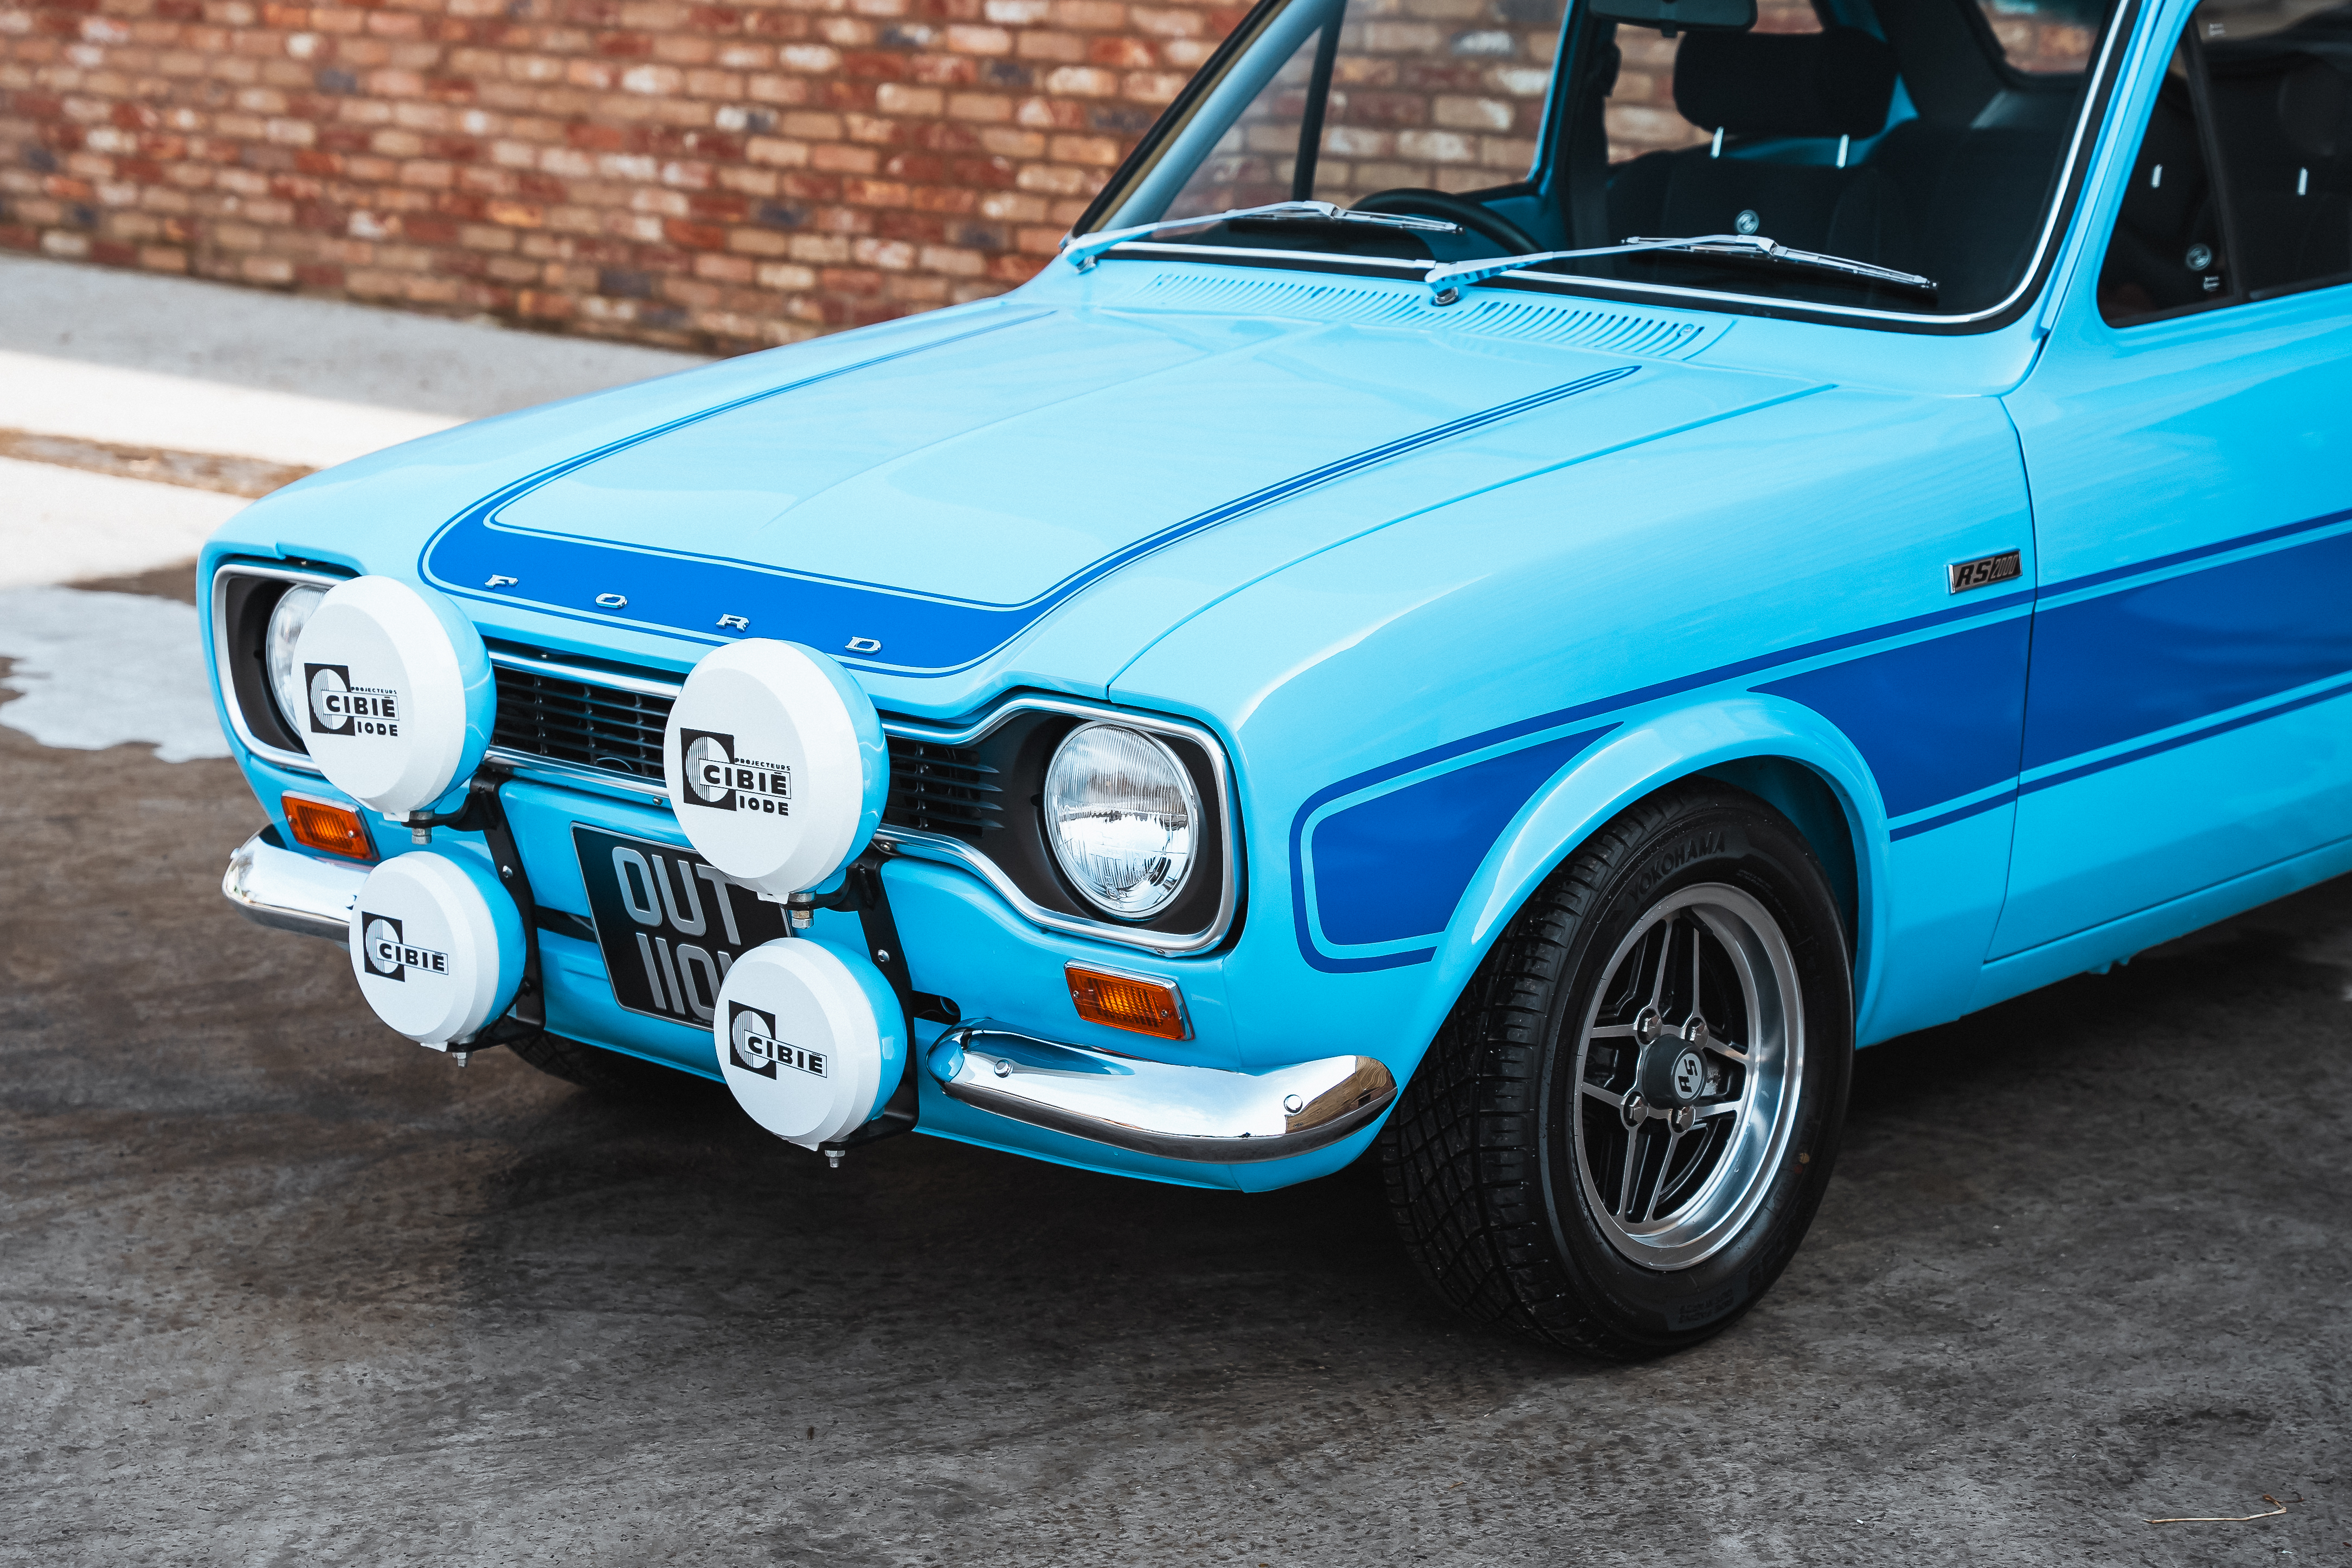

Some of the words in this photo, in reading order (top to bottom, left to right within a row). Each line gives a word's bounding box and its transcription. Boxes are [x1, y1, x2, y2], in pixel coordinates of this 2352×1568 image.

[350, 686, 397, 695] PROJECTEURS
[357, 721, 398, 737] IODE
[735, 757, 791, 771] PROJECTEURS
[739, 795, 789, 817] IODE
[1628, 831, 1725, 903] YOKOHAMA
[612, 846, 742, 946] OUT
[635, 932, 733, 1021] 110
[1678, 1058, 1698, 1093] RS
